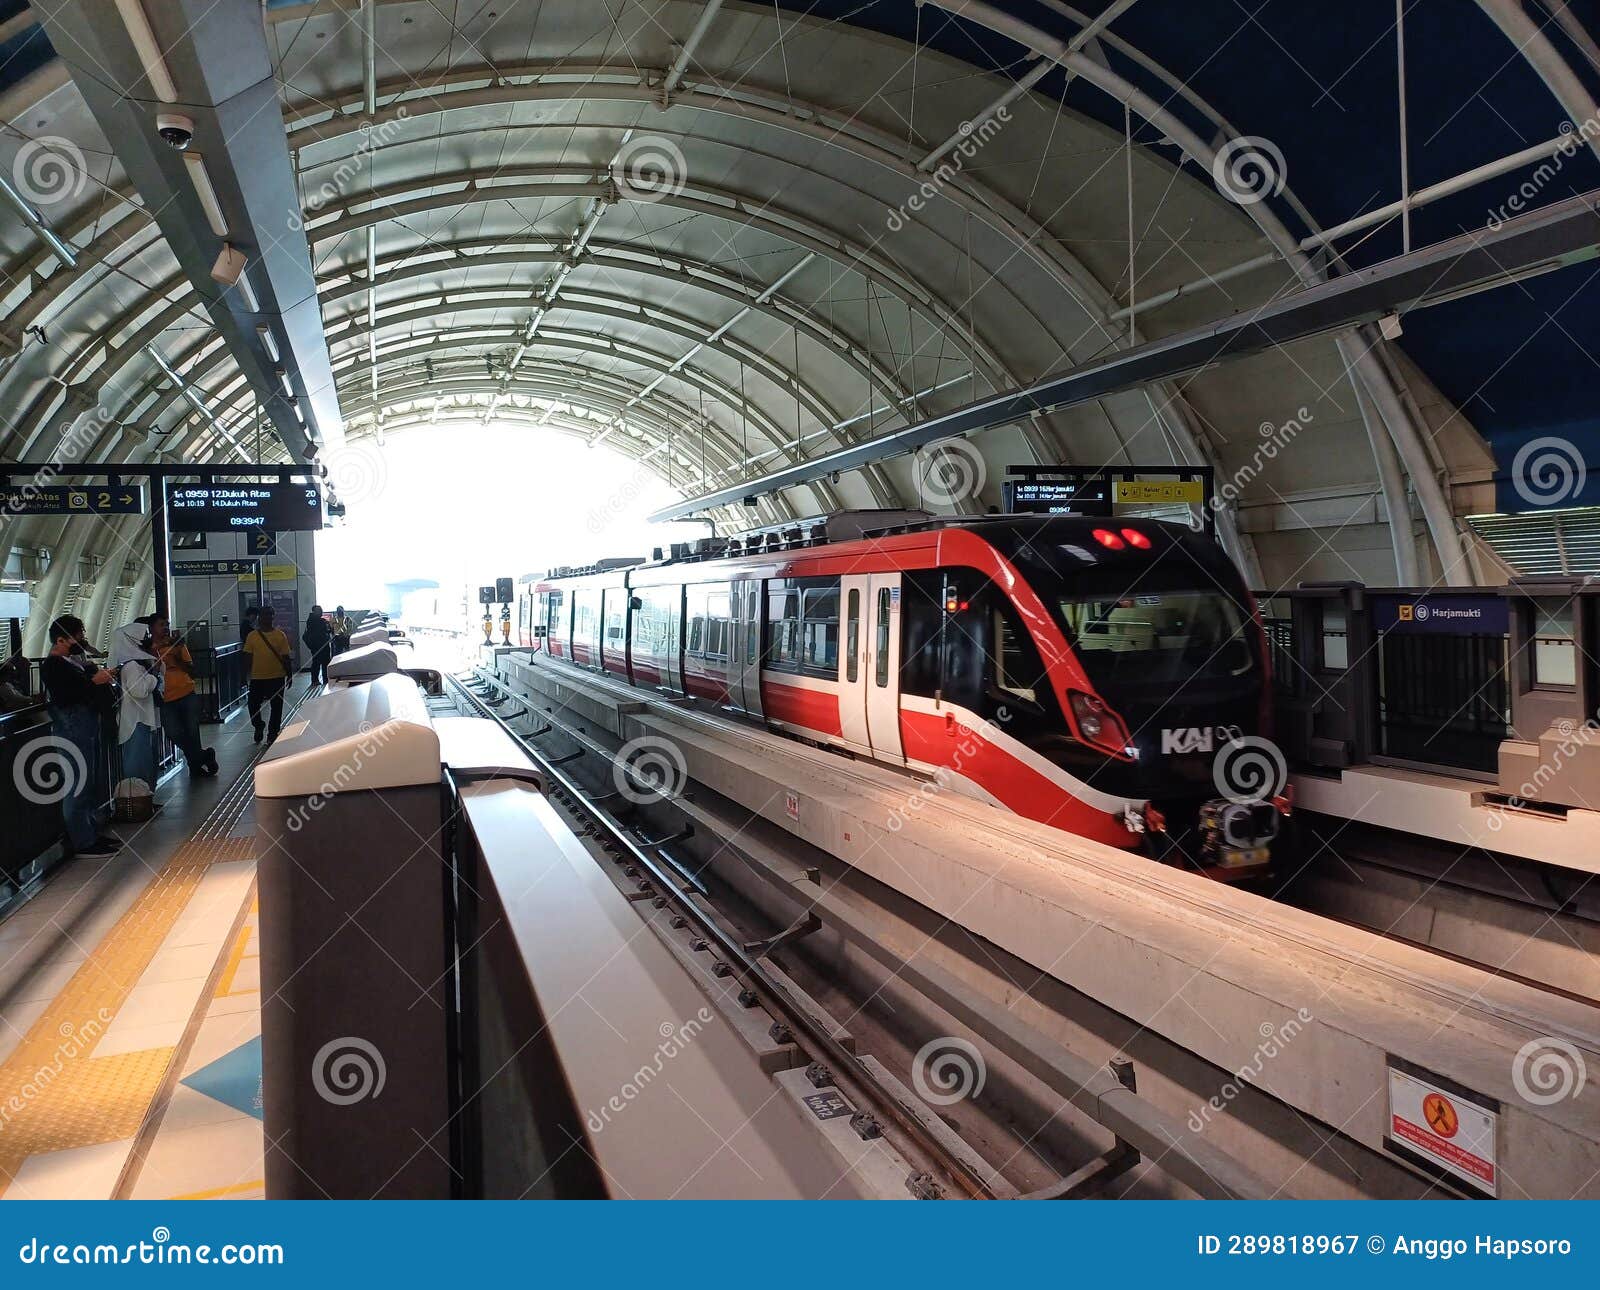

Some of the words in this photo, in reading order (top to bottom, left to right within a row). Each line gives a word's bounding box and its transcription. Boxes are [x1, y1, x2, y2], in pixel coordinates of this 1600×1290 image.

[185, 490, 208, 498] 09:59
[250, 490, 270, 498] Atas
[35, 493, 59, 501] Atas
[98, 492, 111, 508] 2
[230, 517, 265, 525] 09:39:47
[256, 535, 268, 549] 2
[232, 563, 239, 571] 2
[1432, 608, 1481, 619] Harjamukti
[1161, 726, 1213, 755] KAI
